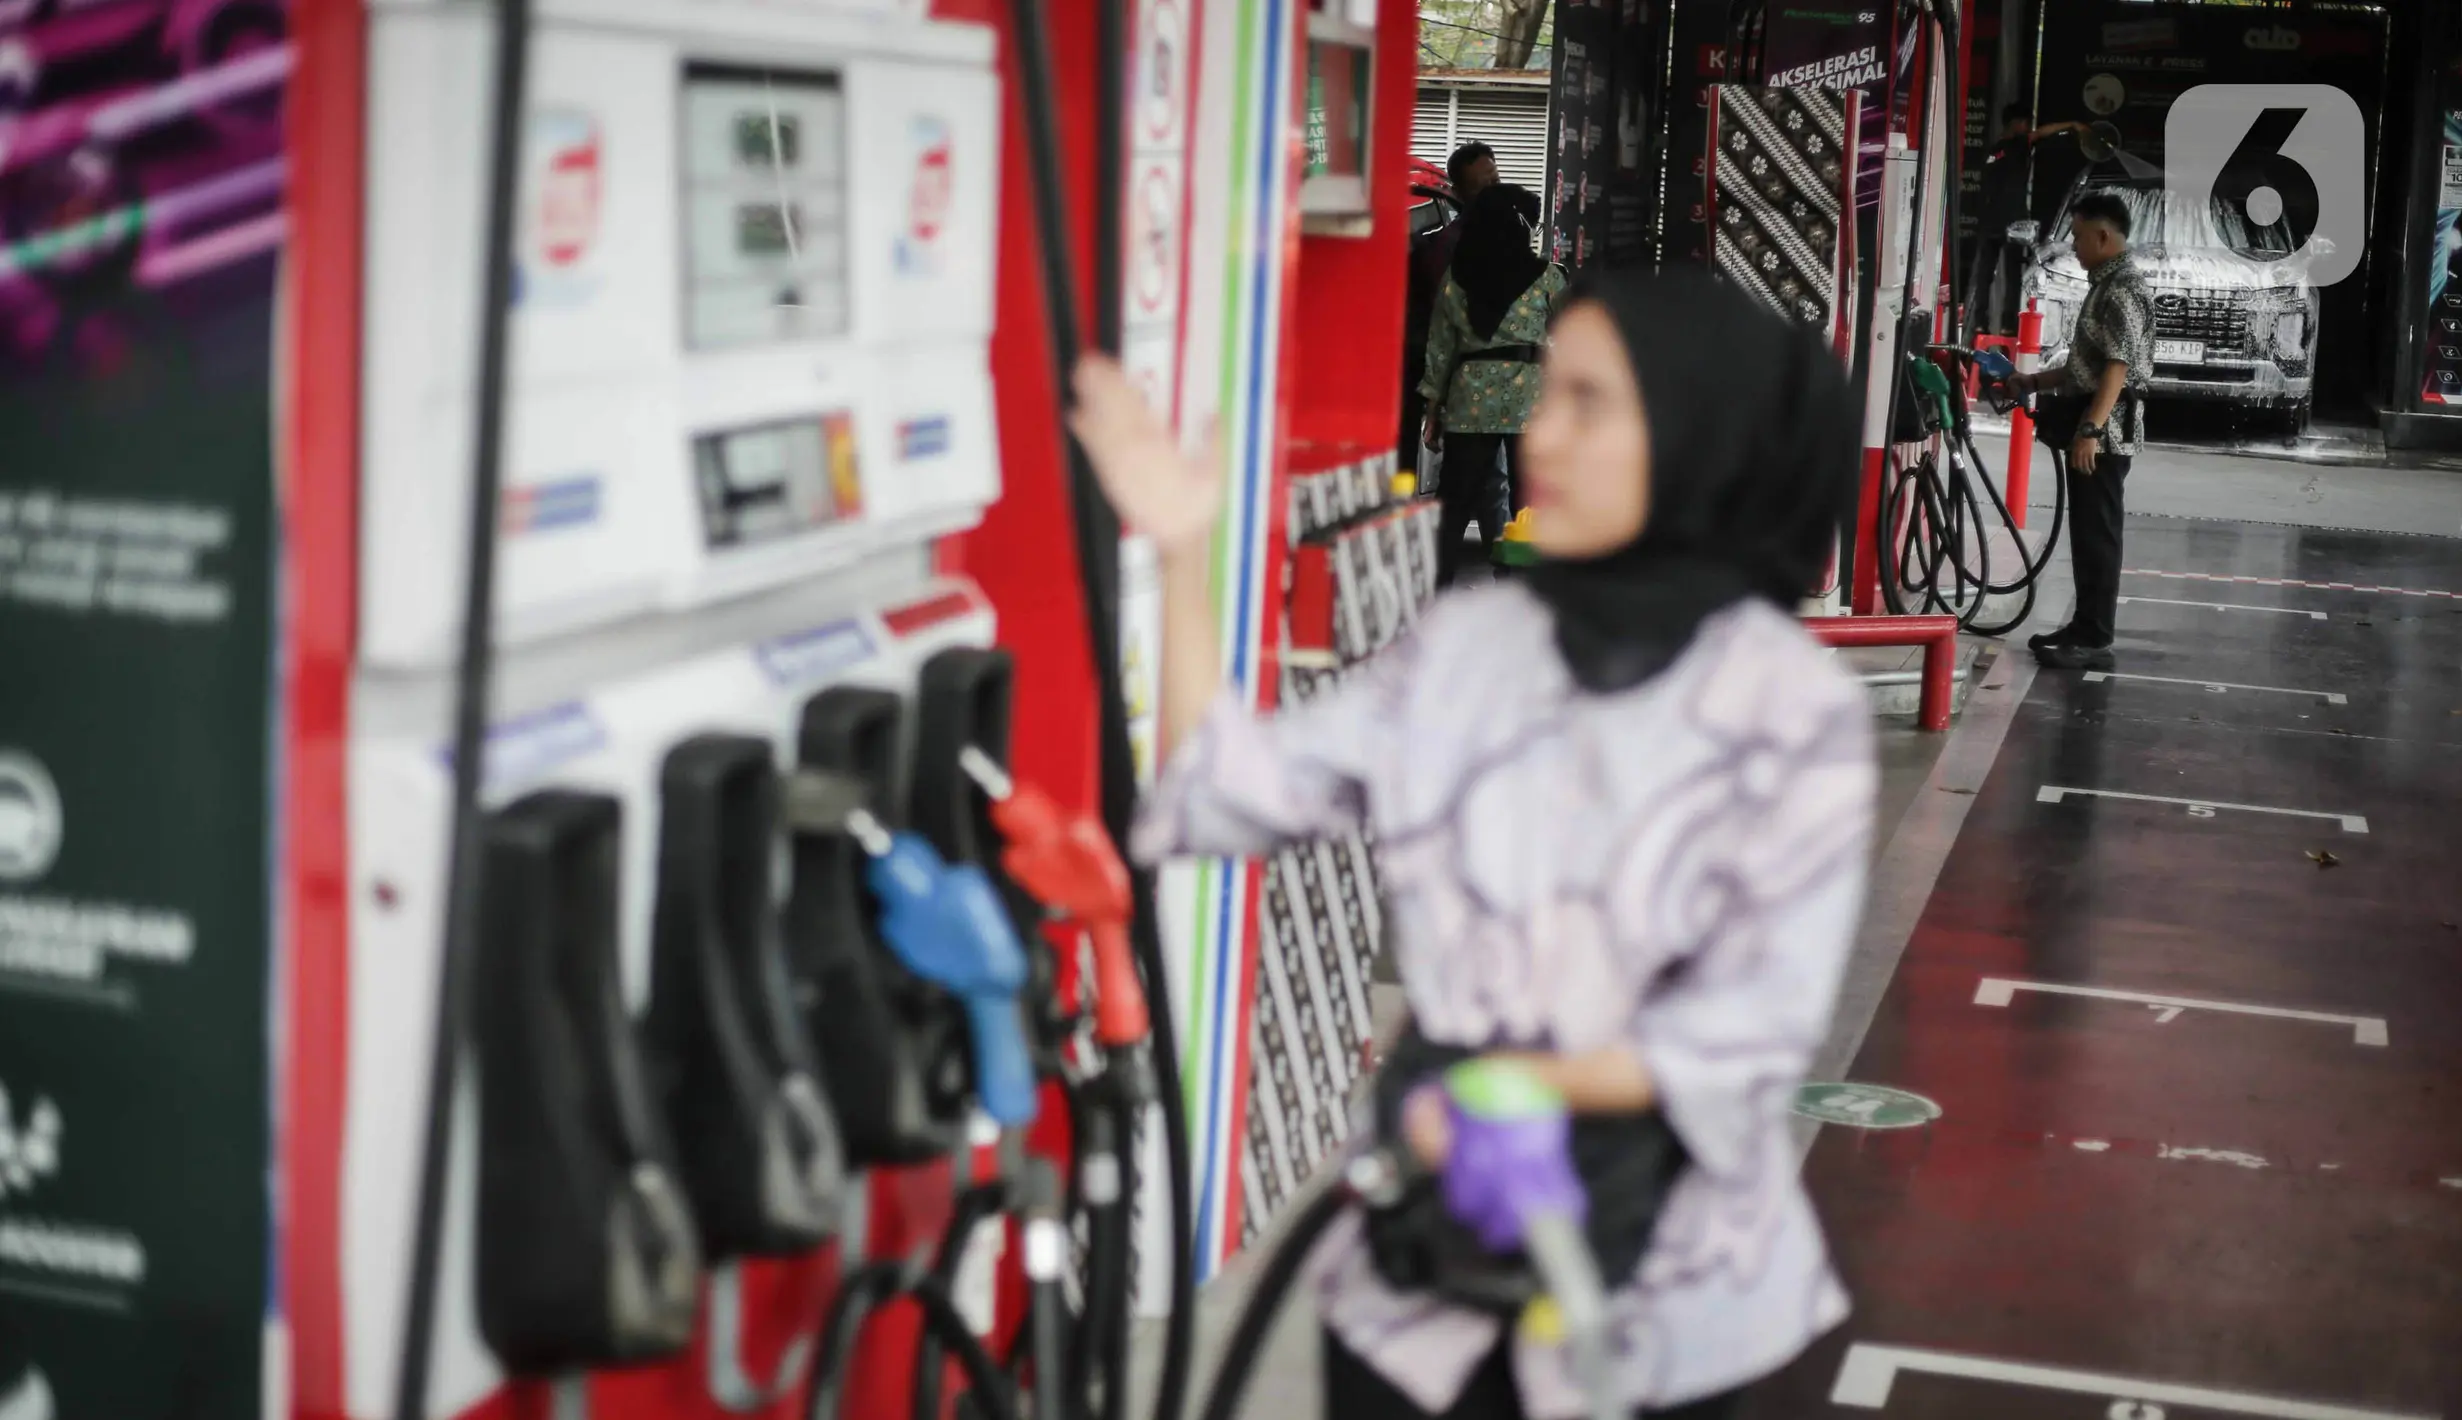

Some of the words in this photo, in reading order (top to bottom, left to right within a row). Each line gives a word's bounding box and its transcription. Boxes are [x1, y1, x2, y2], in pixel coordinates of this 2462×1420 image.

[1858, 12, 1876, 24] 95
[1769, 45, 1876, 87] AKSELERASI
[1800, 61, 1888, 90] KSIMAL
[2148, 1003, 2184, 1023] 7
